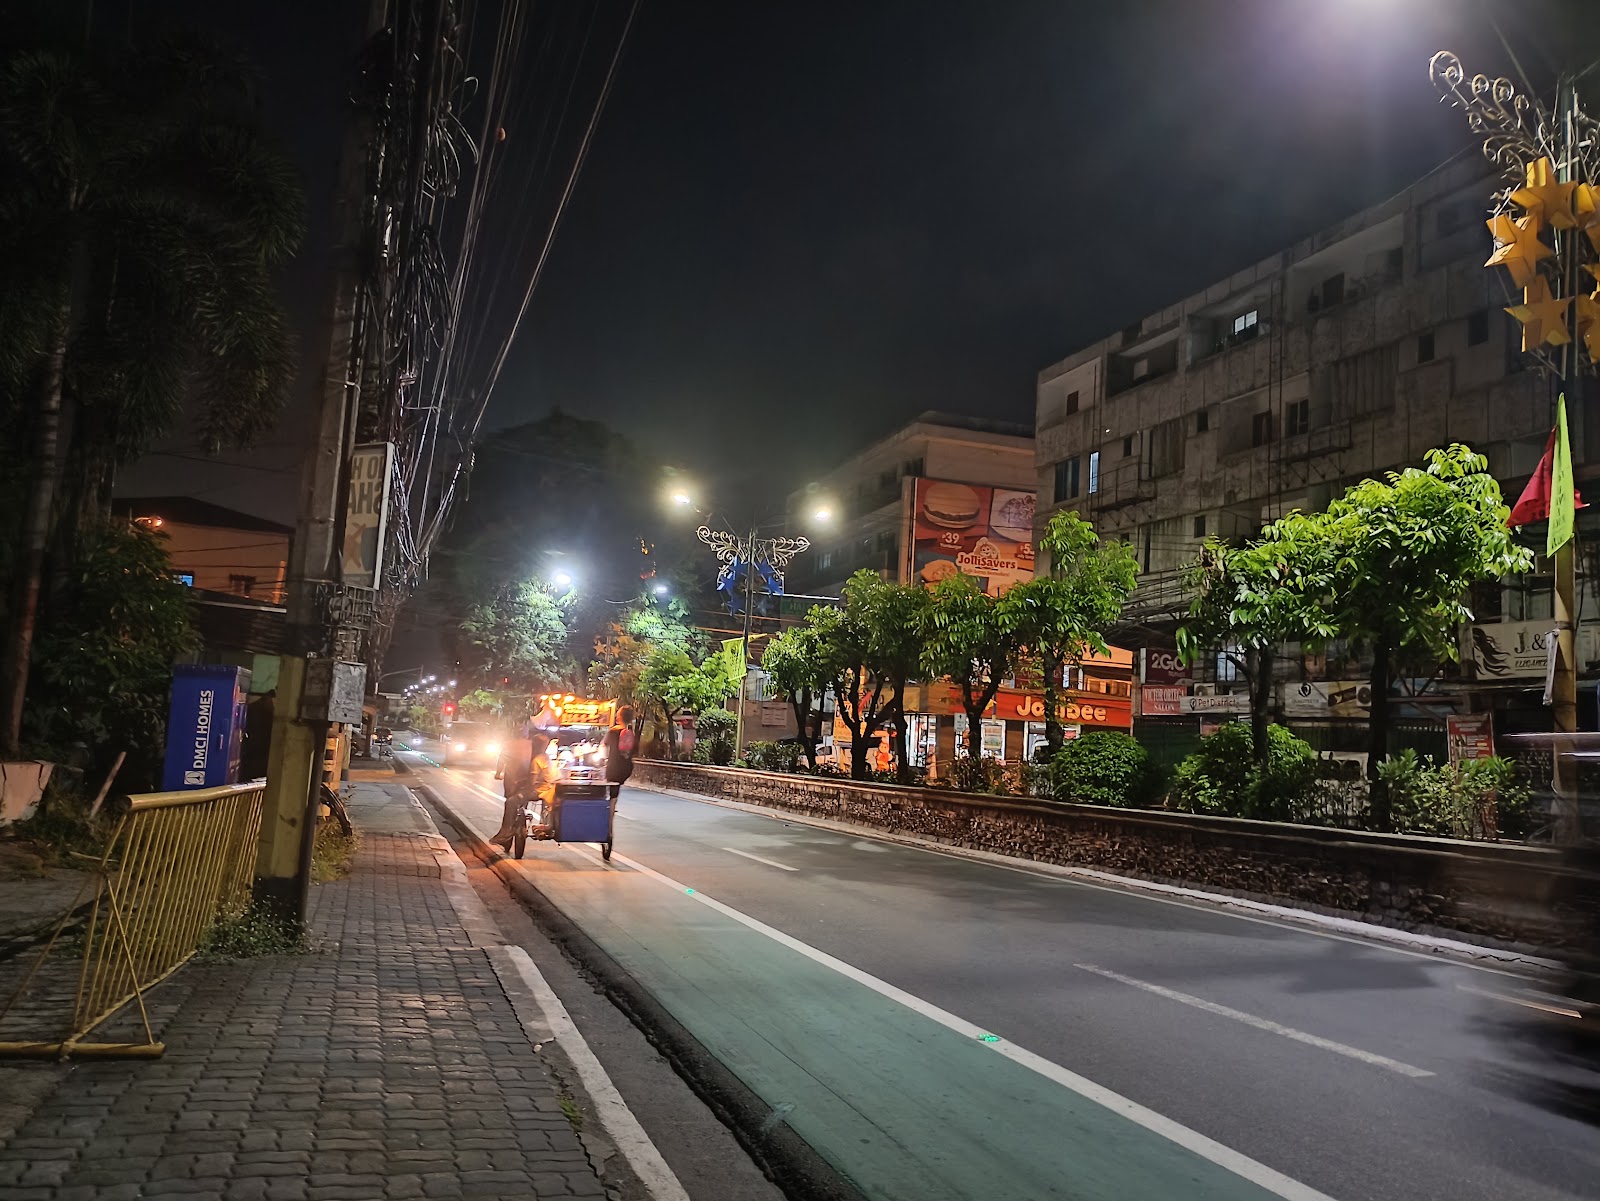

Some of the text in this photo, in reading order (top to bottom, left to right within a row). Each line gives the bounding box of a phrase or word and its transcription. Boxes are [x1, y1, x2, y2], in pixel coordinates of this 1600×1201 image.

[958, 554, 1016, 569] JolliSavers
[1153, 703, 1175, 711] SALON
[193, 689, 213, 769] DMCI HOMES
